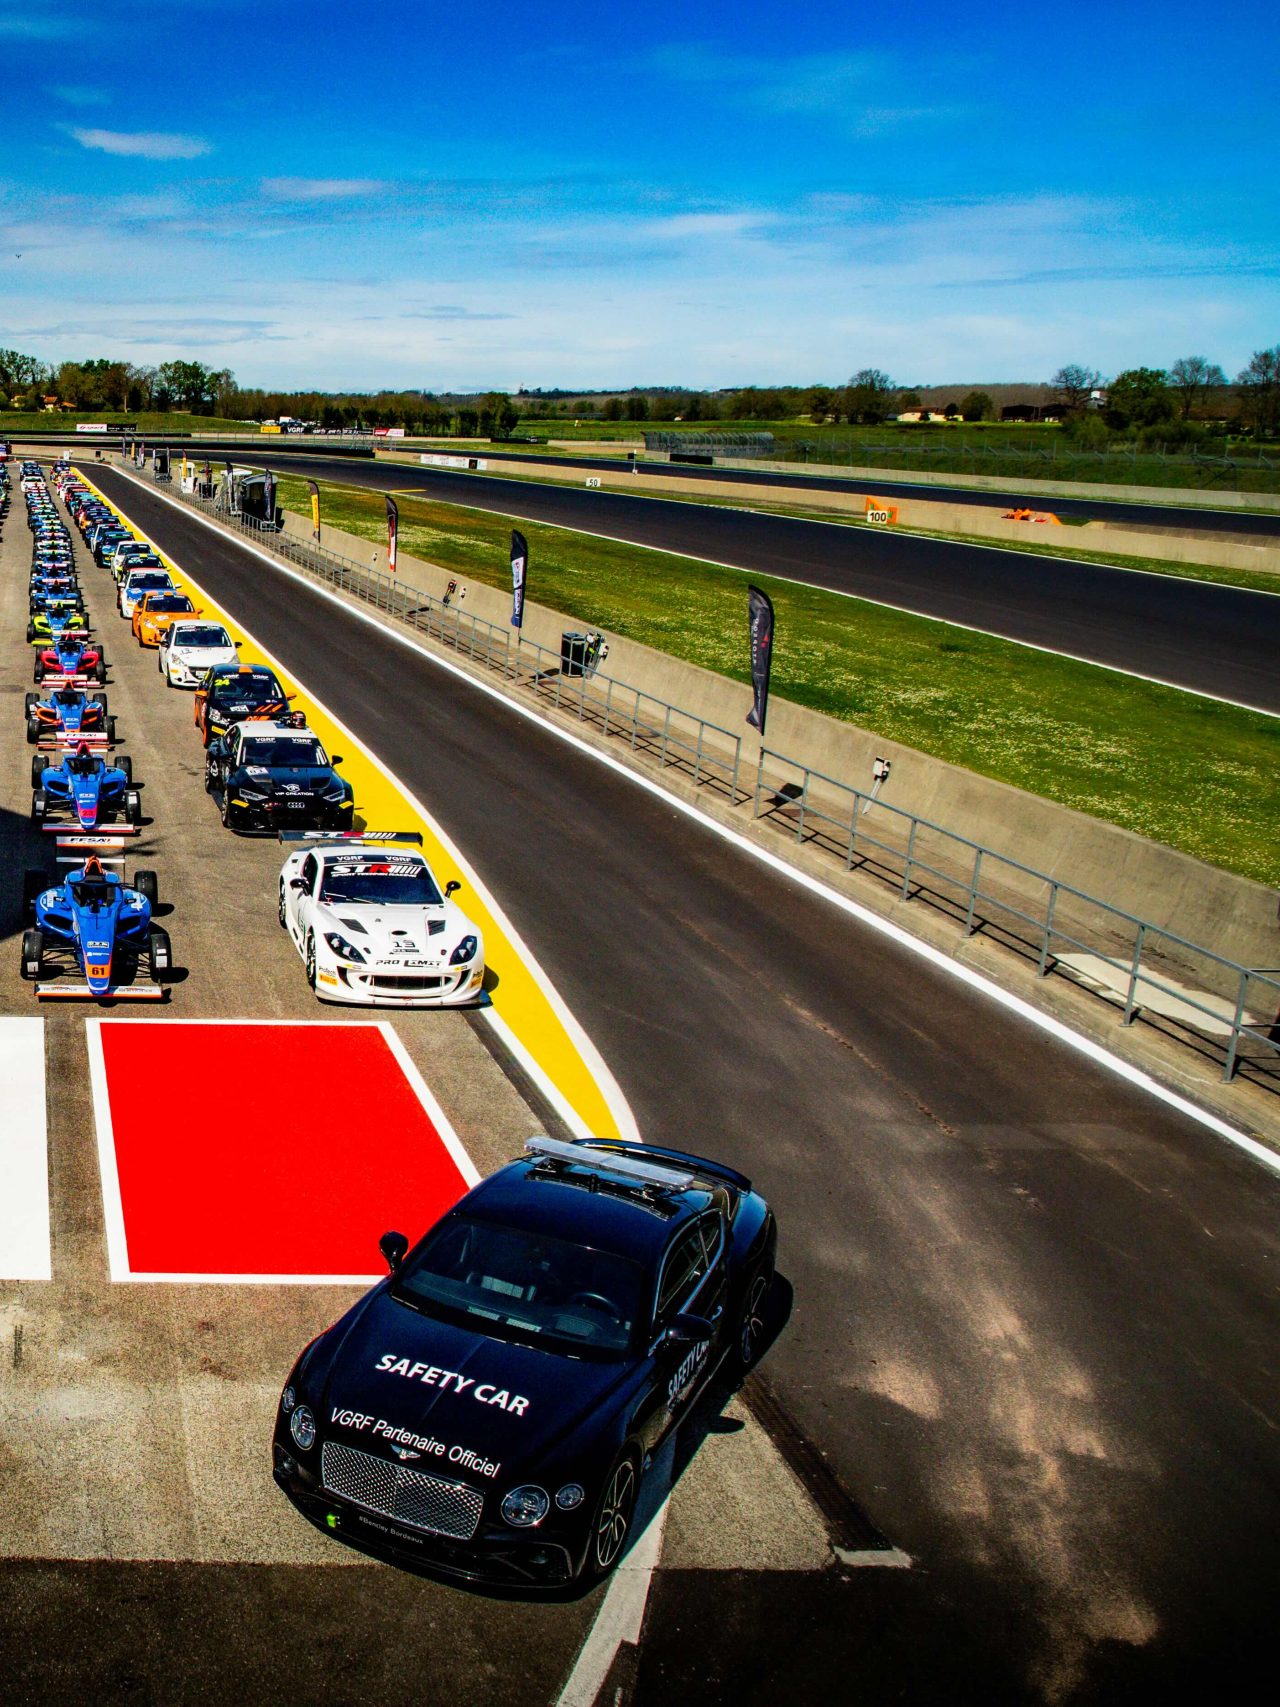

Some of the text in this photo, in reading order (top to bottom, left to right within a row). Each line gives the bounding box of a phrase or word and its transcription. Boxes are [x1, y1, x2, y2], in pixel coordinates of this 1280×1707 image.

[589, 479, 598, 487] 50
[870, 512, 887, 522] 100
[214, 678, 230, 687] 24
[393, 940, 416, 948] 13
[91, 967, 105, 976] 61
[375, 1354, 530, 1417] SAFETY CAR
[331, 1407, 501, 1478] VGRF Partenaire Officiel
[358, 1515, 424, 1545] #Bentley Bordeaux
